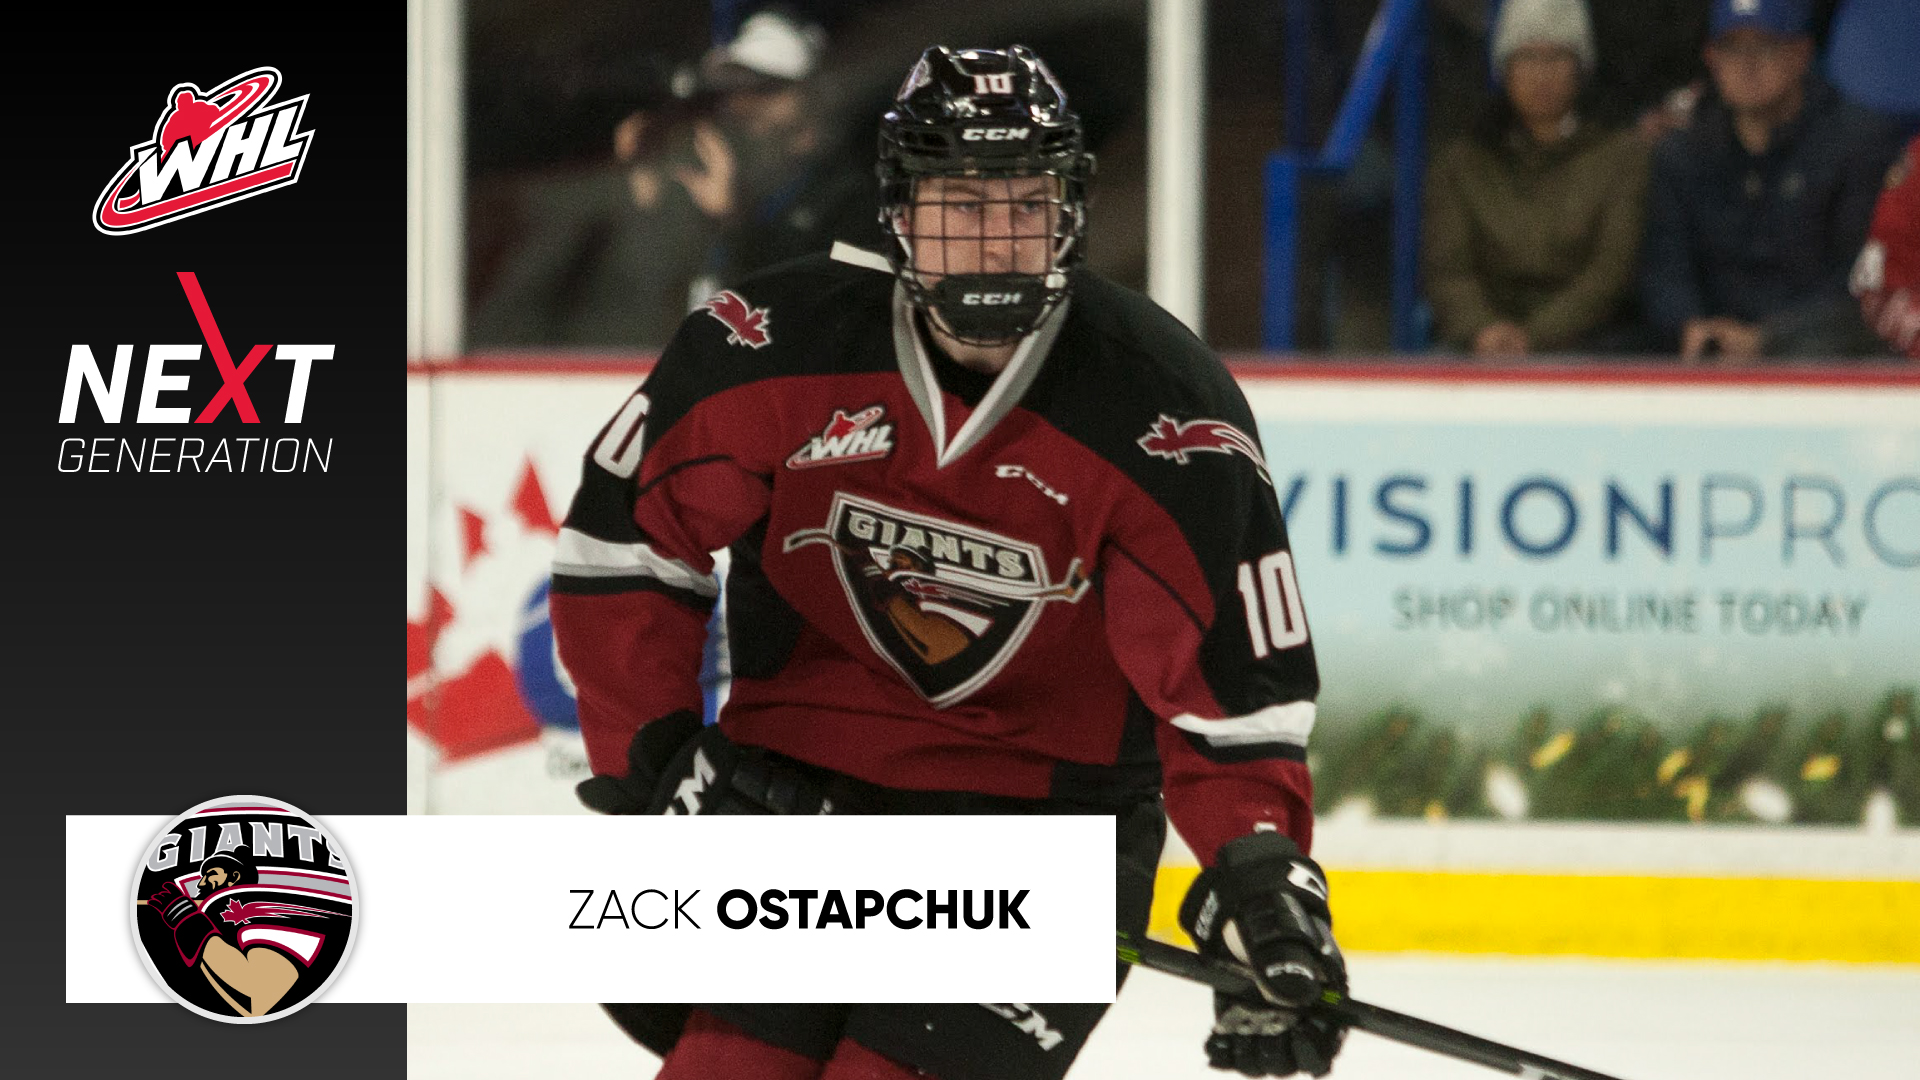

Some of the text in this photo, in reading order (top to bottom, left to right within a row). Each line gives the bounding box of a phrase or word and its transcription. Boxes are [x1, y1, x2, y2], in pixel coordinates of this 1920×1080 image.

[974, 73, 1013, 95] 10
[962, 128, 1031, 141] CCM
[811, 425, 893, 462] WHL
[848, 510, 1026, 579] GIANTS
[1238, 550, 1308, 659] 10
[1392, 587, 1871, 637] SHOP ONLINE TODAY
